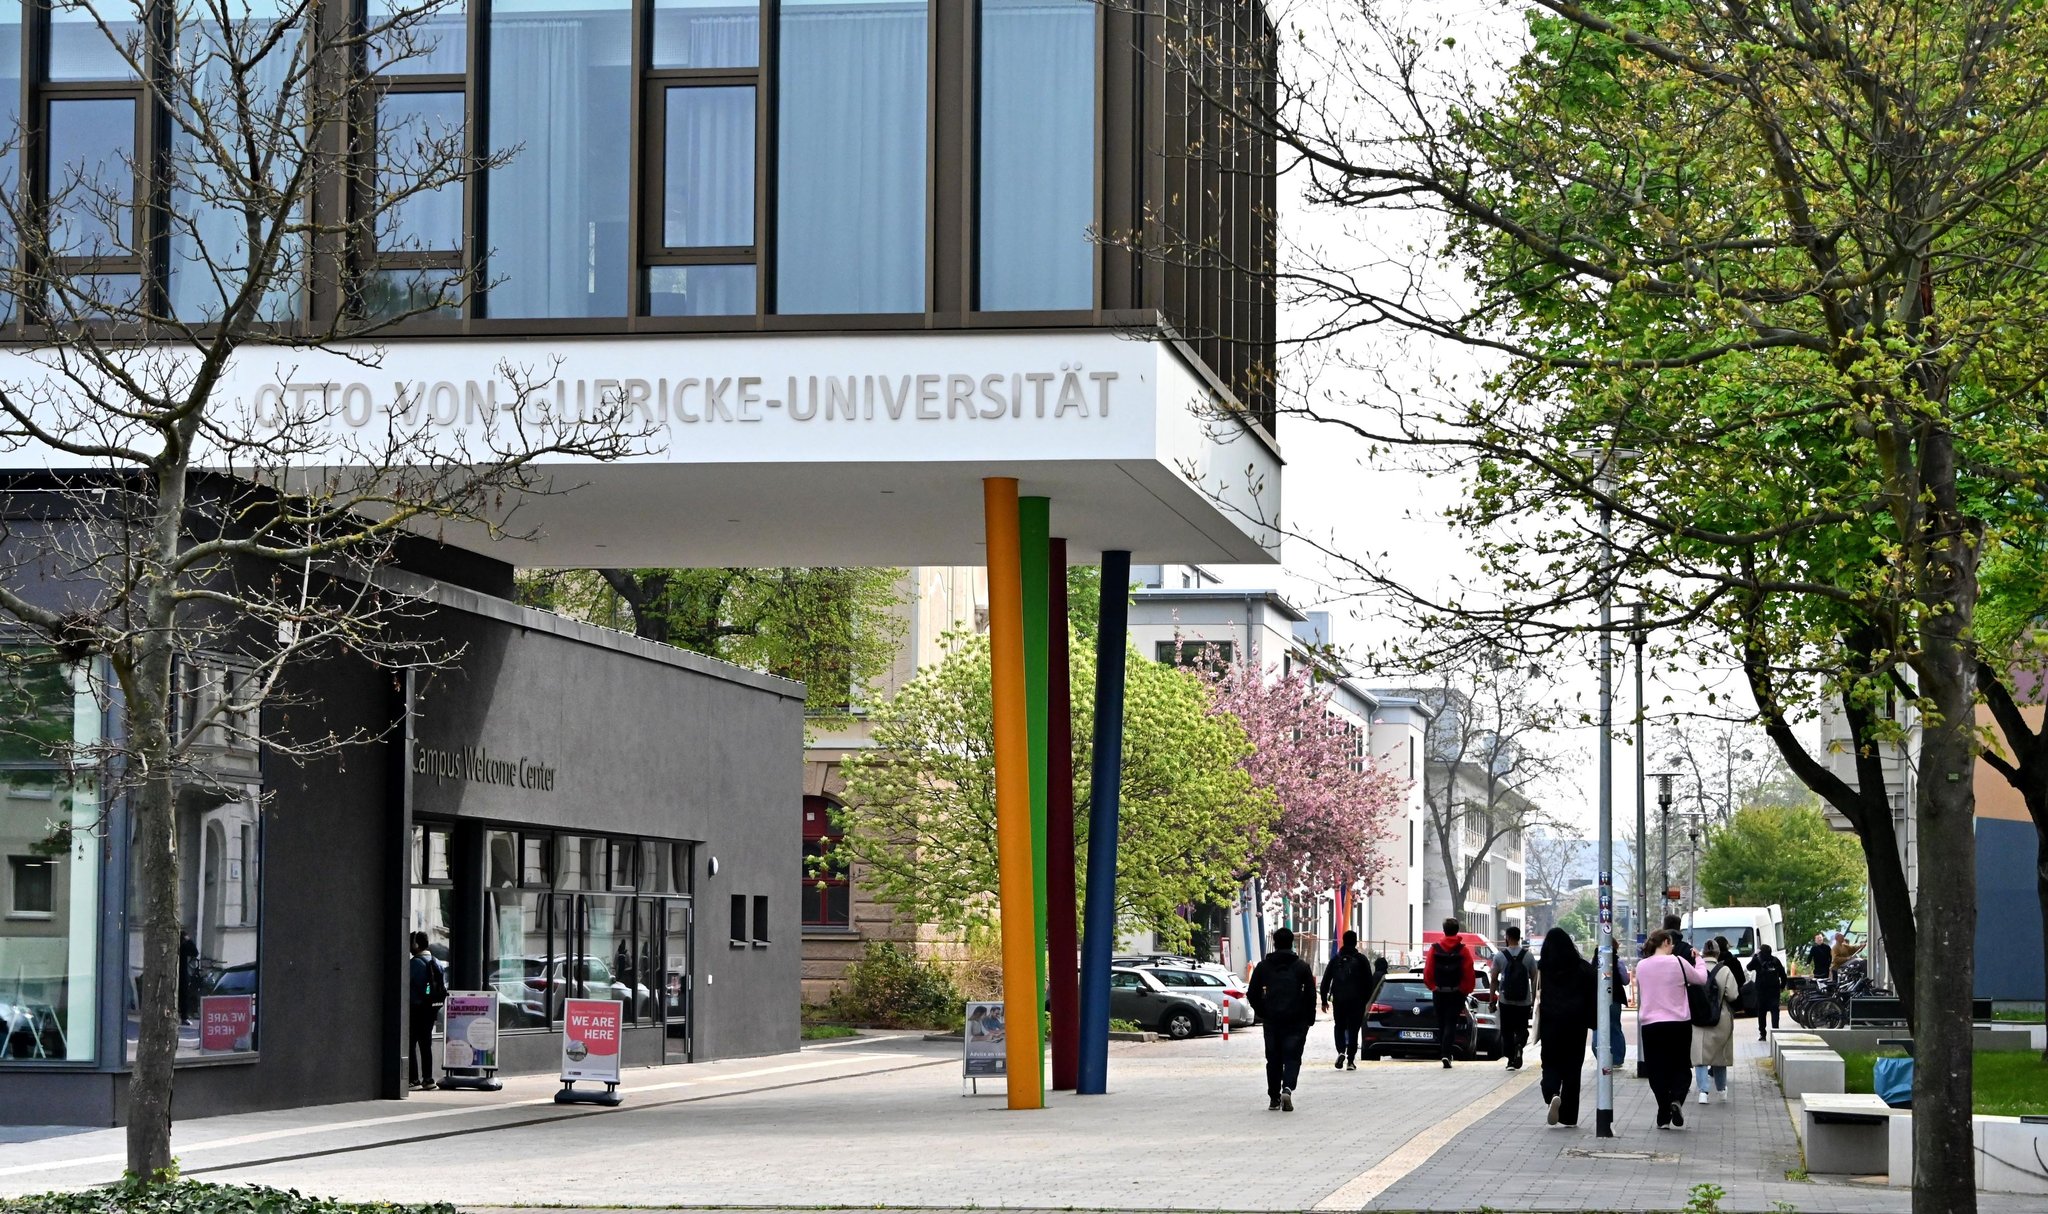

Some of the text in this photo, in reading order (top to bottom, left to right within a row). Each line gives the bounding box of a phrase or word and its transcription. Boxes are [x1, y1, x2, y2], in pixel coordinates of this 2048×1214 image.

[254, 362, 1119, 430] OTTO-VON-GUERICKE-UNIVERSITÄT
[412, 737, 557, 792] Campus Welcome Center
[571, 1015, 615, 1028] WE ARE
[584, 1029, 615, 1040] HERE
